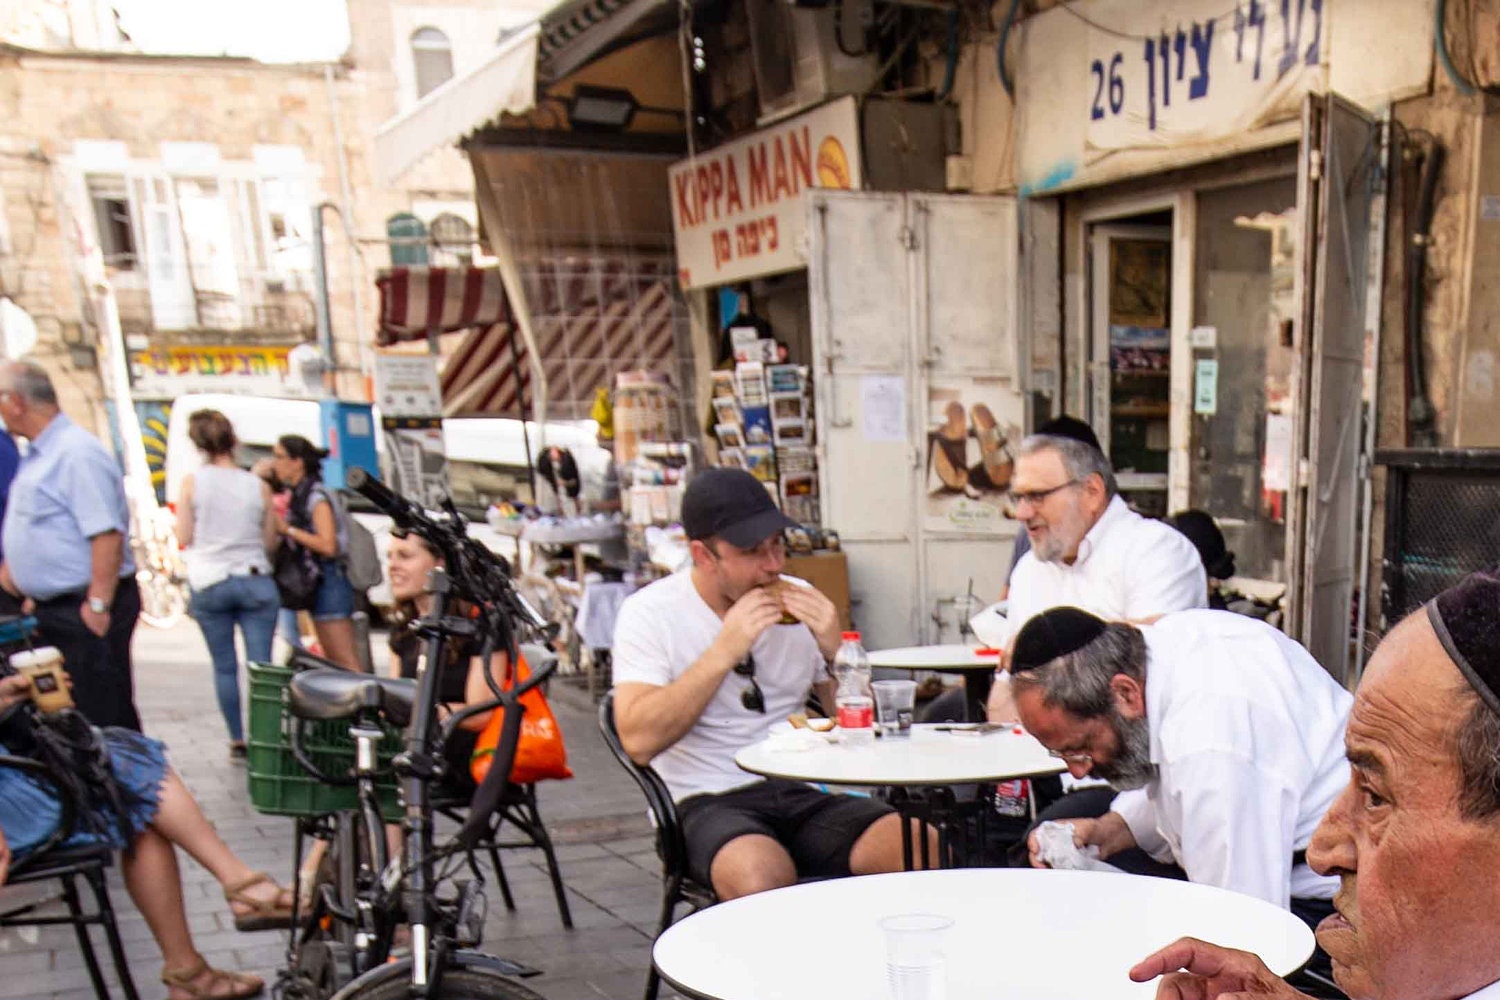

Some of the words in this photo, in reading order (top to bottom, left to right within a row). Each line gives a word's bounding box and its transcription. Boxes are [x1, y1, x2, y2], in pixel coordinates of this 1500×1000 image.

[1091, 51, 1124, 120] 26
[1145, 18, 1217, 131] ציון
[675, 153, 743, 229] KIPPA
[748, 124, 814, 209] MAN
